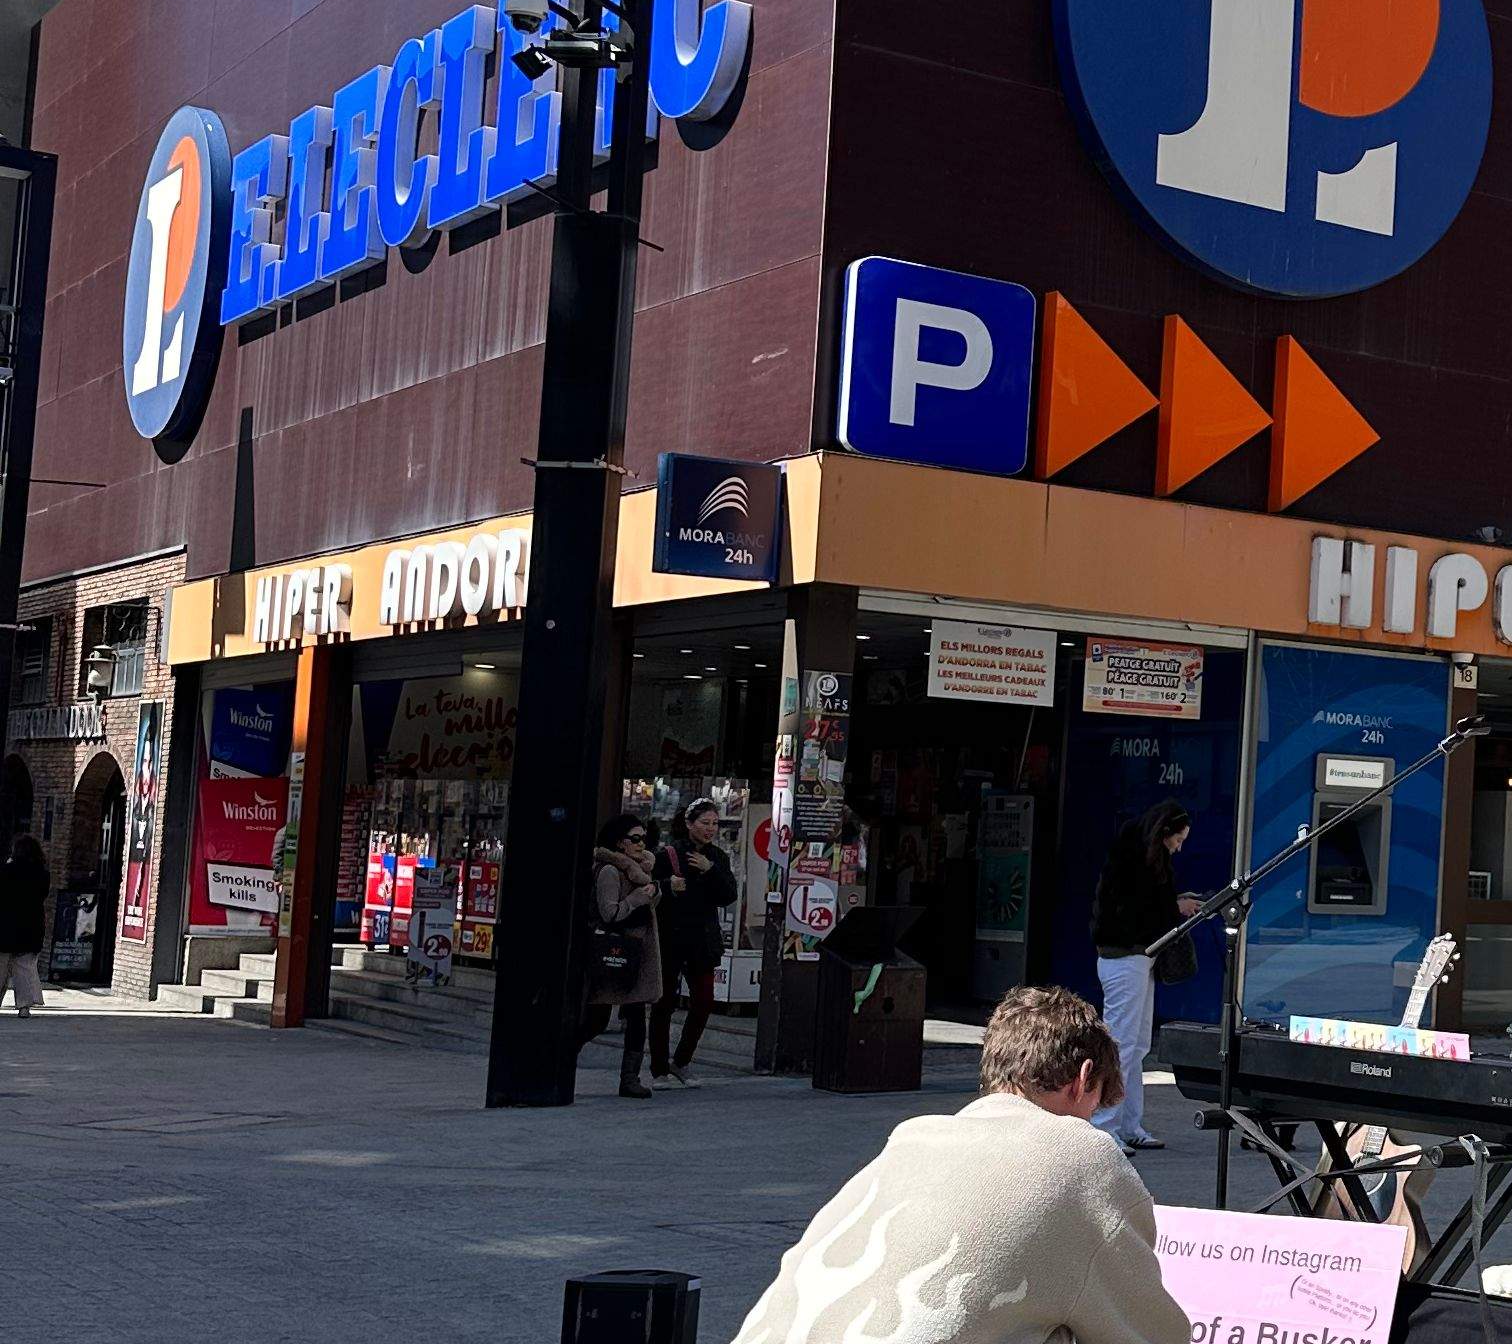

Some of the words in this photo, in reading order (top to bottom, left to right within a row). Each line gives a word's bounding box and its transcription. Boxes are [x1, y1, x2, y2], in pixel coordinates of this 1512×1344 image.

[888, 297, 994, 427] P
[724, 548, 753, 565] 24h
[253, 563, 352, 644] HIPER
[941, 640, 959, 651] ELS
[960, 643, 1003, 656] MILLORS
[1005, 647, 1044, 660] REGALS
[937, 656, 997, 670] D'ANDORRA
[998, 660, 1012, 671] EN
[1014, 663, 1047, 674] TABAC
[1109, 656, 1141, 669] PEATGE
[937, 669, 953, 679] LES
[954, 671, 1003, 683] MEILLEURS
[1004, 675, 1046, 687] CADEAUX
[1107, 669, 1140, 684] PÉAGE
[1140, 674, 1180, 688] GRATUIT
[1459, 668, 1473, 683] 18
[943, 682, 994, 695] D'ANDORRE
[1010, 688, 1038, 699] TABAC
[1180, 692, 1187, 704] 2
[405, 697, 431, 720] La
[230, 707, 272, 733] Winston
[1326, 712, 1393, 729] MORABANC
[1361, 729, 1385, 744] 24h
[1158, 762, 1184, 785] 24h
[222, 800, 277, 821] Winston
[212, 871, 275, 893] Smoking
[229, 888, 257, 902] kills
[1361, 1063, 1392, 1078] Roland
[1201, 1243, 1225, 1260] us
[1230, 1245, 1254, 1263] on
[1261, 1244, 1362, 1274] Instagram
[1190, 1316, 1222, 1344] of
